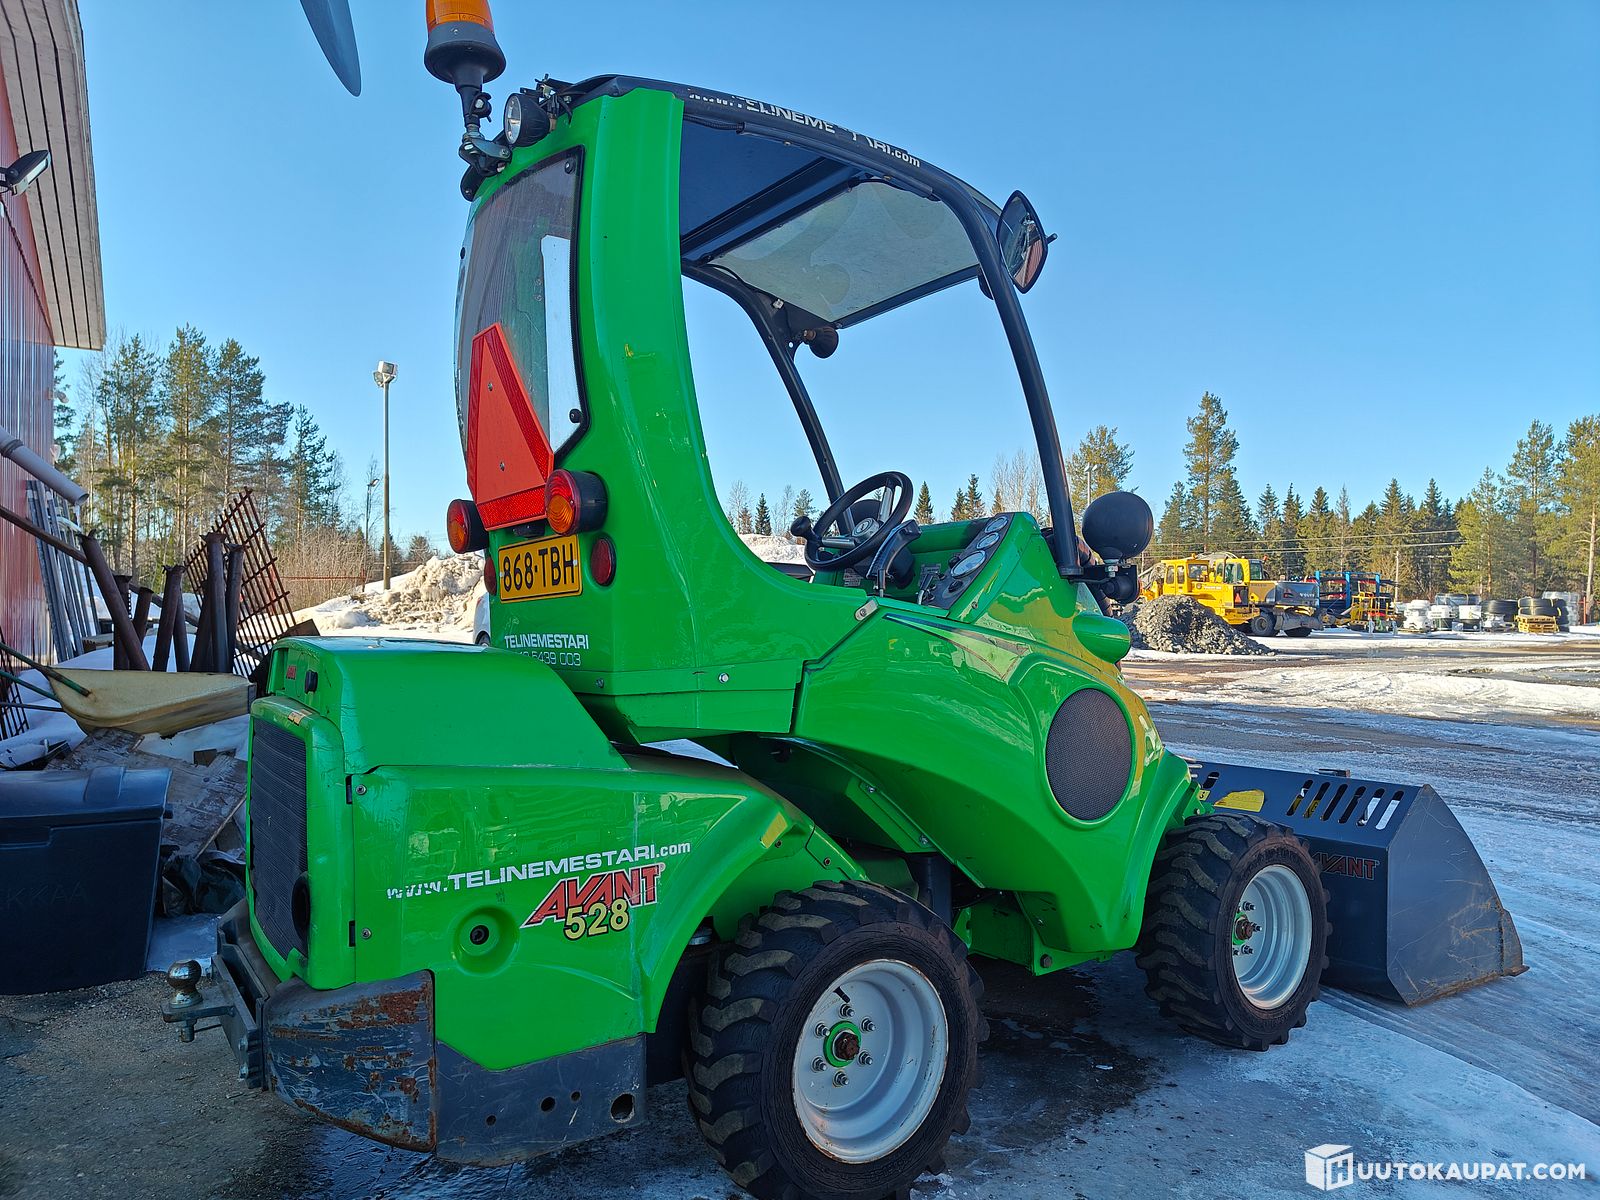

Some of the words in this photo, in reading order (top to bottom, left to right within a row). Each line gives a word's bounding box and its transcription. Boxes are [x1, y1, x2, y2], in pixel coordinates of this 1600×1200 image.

[503, 543, 575, 593] 868-TBH
[504, 633, 590, 650] TELINEMESTARI
[560, 652, 581, 667] 003
[520, 863, 660, 929] AVANT
[563, 897, 630, 940] 528
